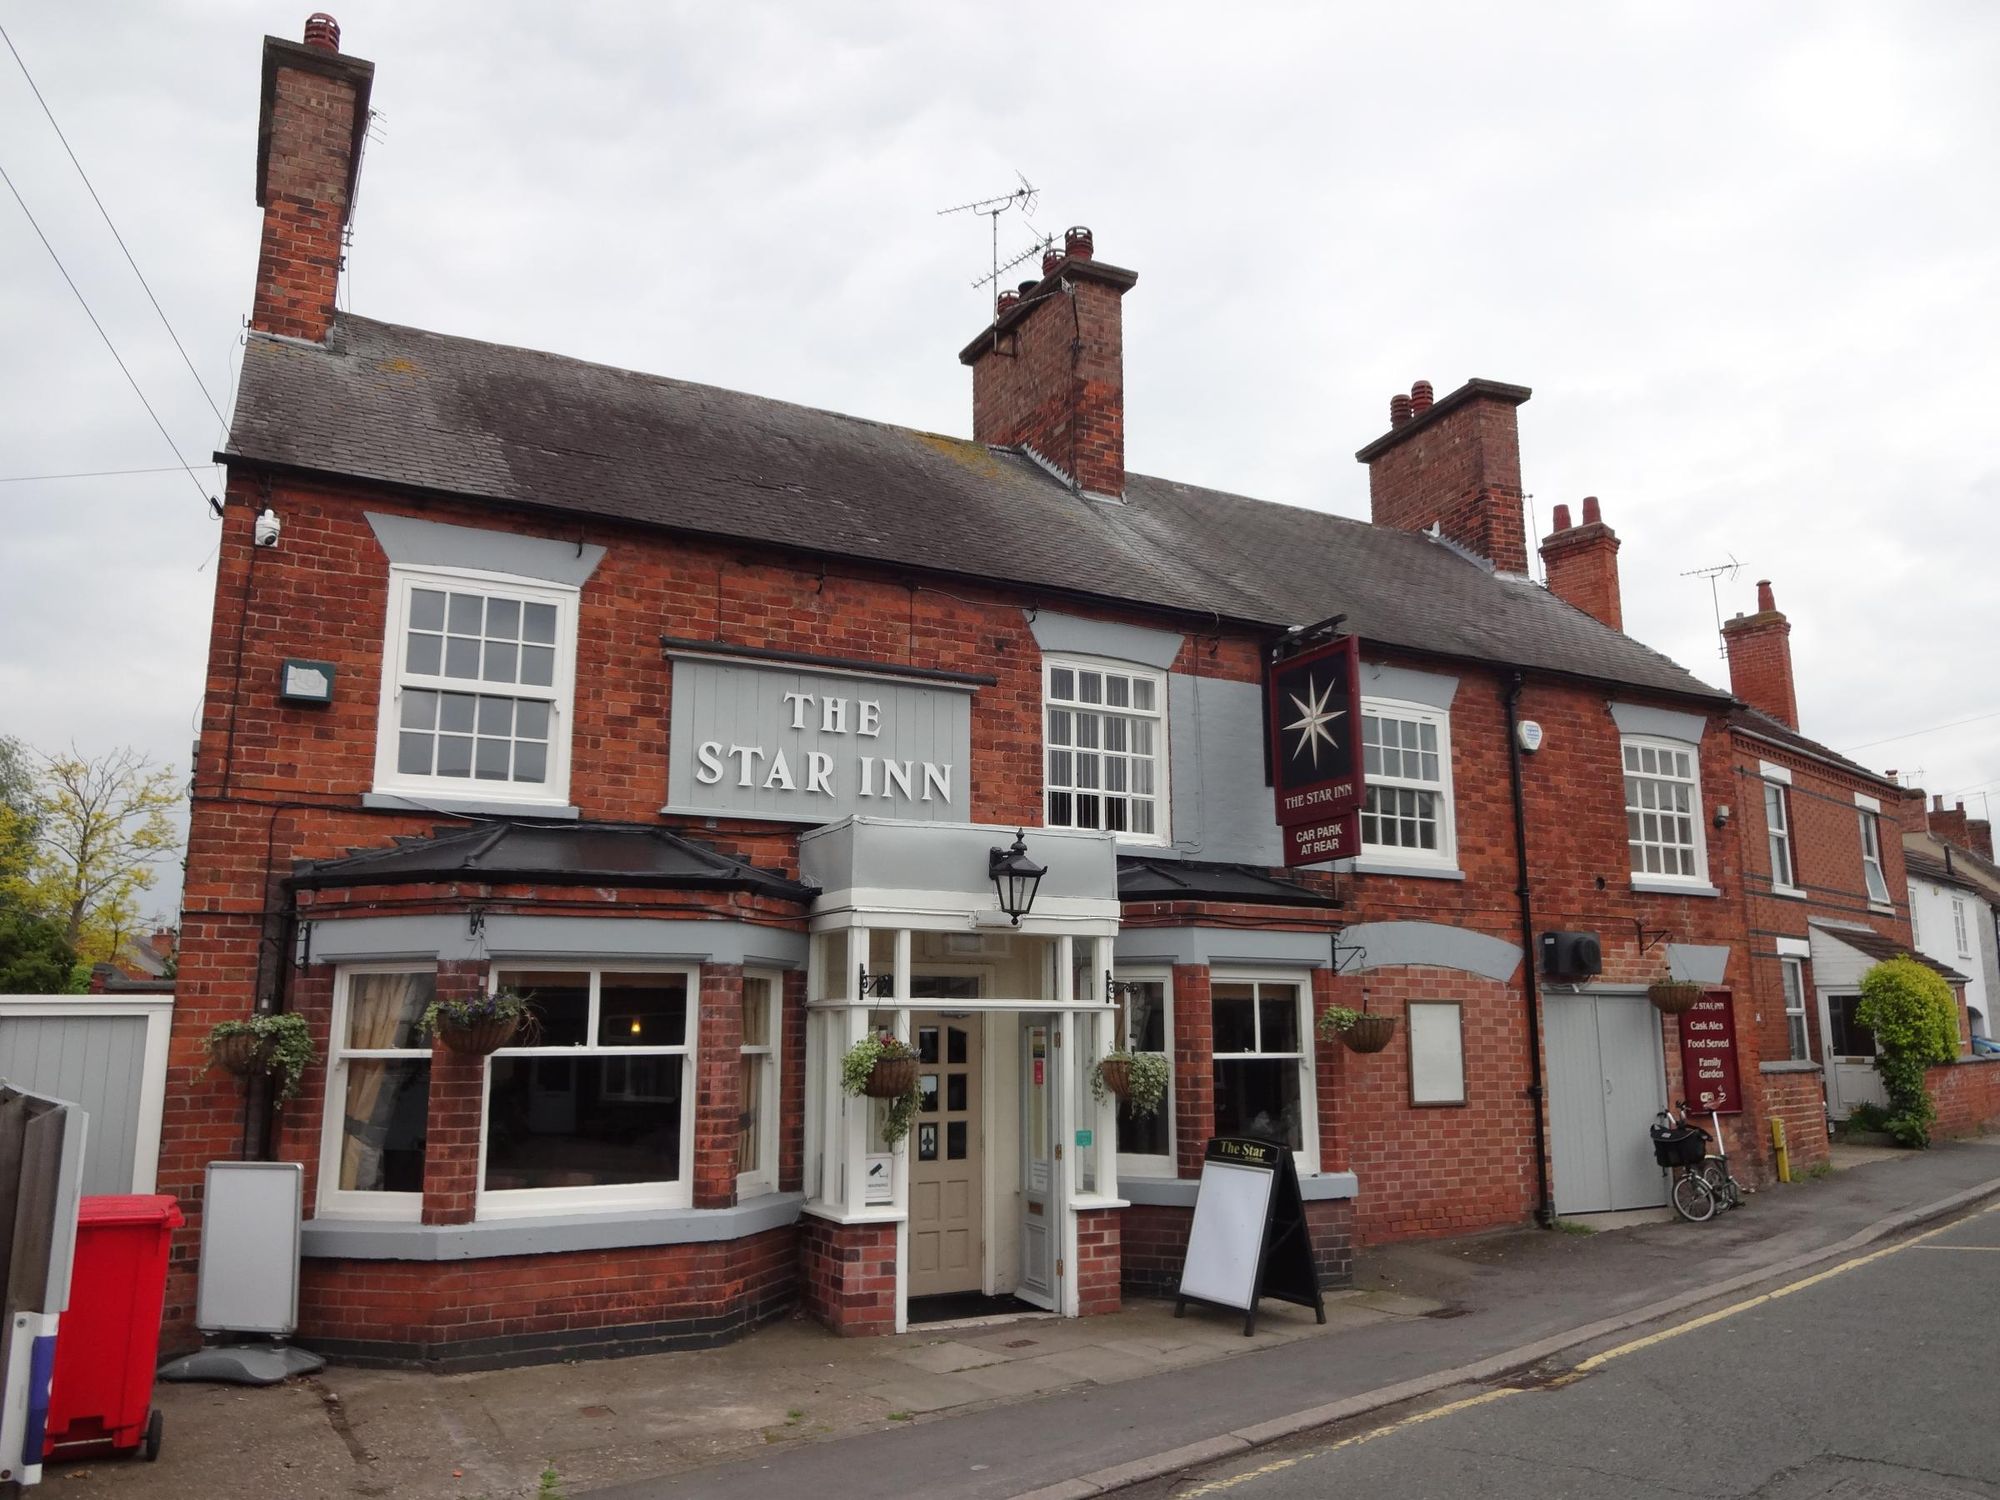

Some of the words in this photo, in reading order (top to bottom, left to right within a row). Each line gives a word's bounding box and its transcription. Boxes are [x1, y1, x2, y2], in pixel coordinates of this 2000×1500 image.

[783, 690, 882, 738] THE
[696, 741, 835, 798] STAR
[858, 756, 953, 804] INN
[1285, 794, 1305, 810] THE
[1306, 789, 1333, 805] STAR
[1334, 783, 1352, 798] INN
[1296, 830, 1315, 842] CAR
[1317, 823, 1342, 838] PARK
[1301, 843, 1313, 856] AT
[1314, 838, 1339, 852] REAR
[1690, 1021, 1707, 1030] Cask
[1709, 1021, 1724, 1030] Ales
[1687, 1039, 1705, 1048] Food
[1706, 1038, 1729, 1048] Served
[1699, 1057, 1722, 1069] Family
[1699, 1069, 1724, 1078] Garden
[1221, 1141, 1240, 1154] The
[1242, 1143, 1265, 1157] Star
